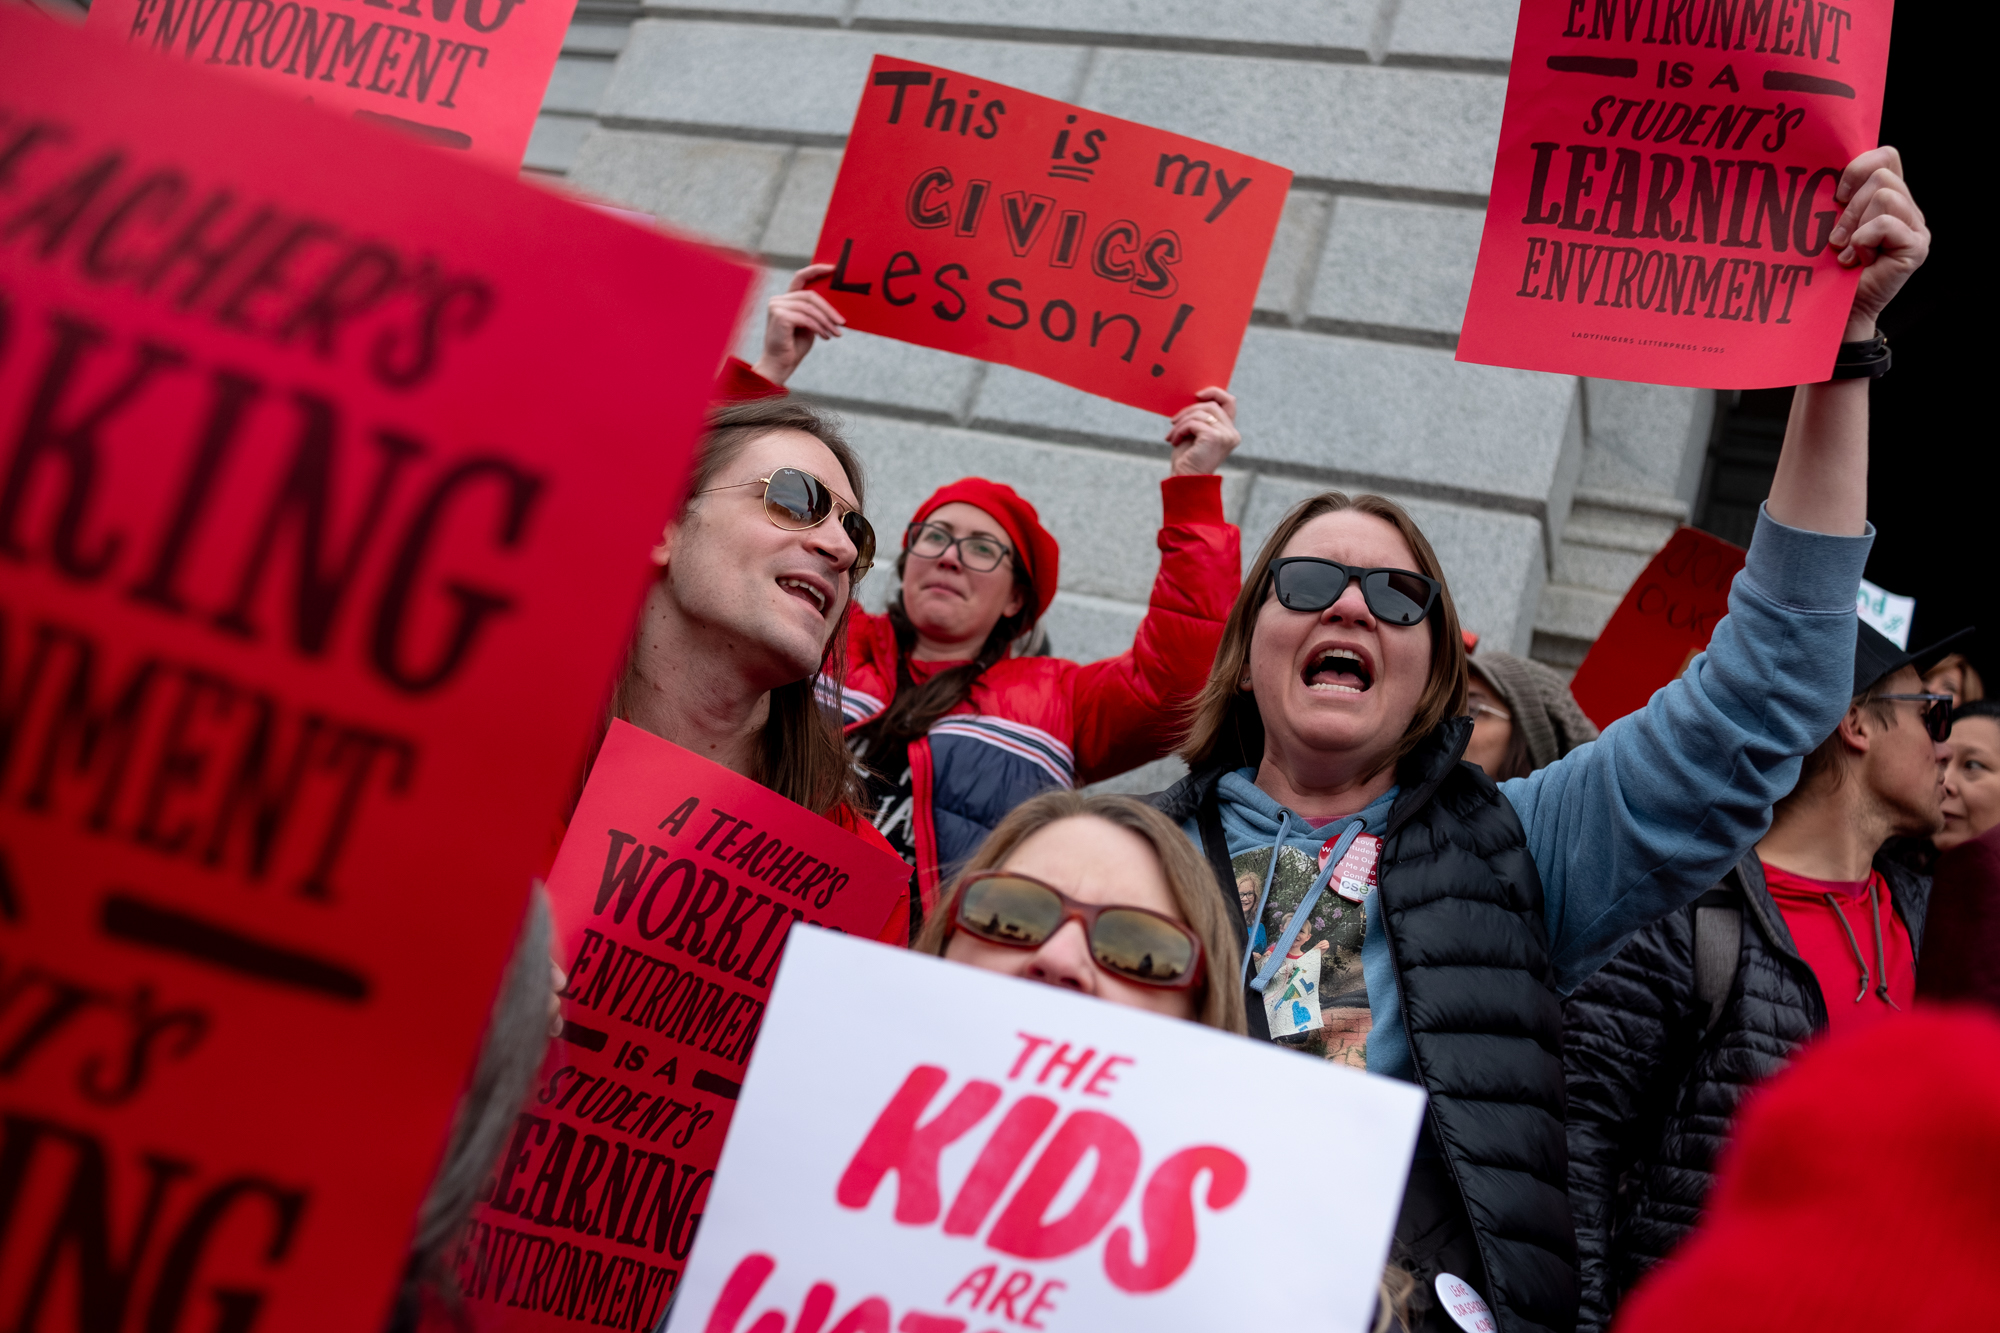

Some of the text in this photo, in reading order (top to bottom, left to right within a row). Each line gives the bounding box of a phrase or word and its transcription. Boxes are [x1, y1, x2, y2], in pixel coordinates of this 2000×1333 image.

[1562, 0, 1852, 64] ENVIRONMENT
[1656, 60, 1740, 93] IS A
[873, 71, 1252, 224] This is my
[1583, 95, 1806, 154] STUDENT'S
[906, 166, 1183, 299] CIVICS
[1521, 141, 1848, 258] LEARNING
[829, 237, 1196, 378] Lesson!
[1516, 237, 1813, 325] ENVIRONMENT
[1571, 332, 1634, 344] LADYFINGERS
[1638, 339, 1697, 351] LETTERPRESS
[0, 296, 553, 697] KING
[658, 796, 700, 838] A
[694, 807, 850, 910] TEACHER'S
[1343, 870, 1377, 885] Contrac
[1349, 845, 1379, 857] tudent
[1360, 866, 1376, 876] Abo
[592, 828, 848, 989] WORKI
[559, 928, 766, 1066] ENVIRONMEN
[613, 1040, 678, 1085] IS A
[1005, 1031, 1136, 1098] THE
[537, 1065, 713, 1150] STUDENT'S
[835, 1064, 1250, 1296] KIDS
[945, 1263, 1068, 1331] ARE
